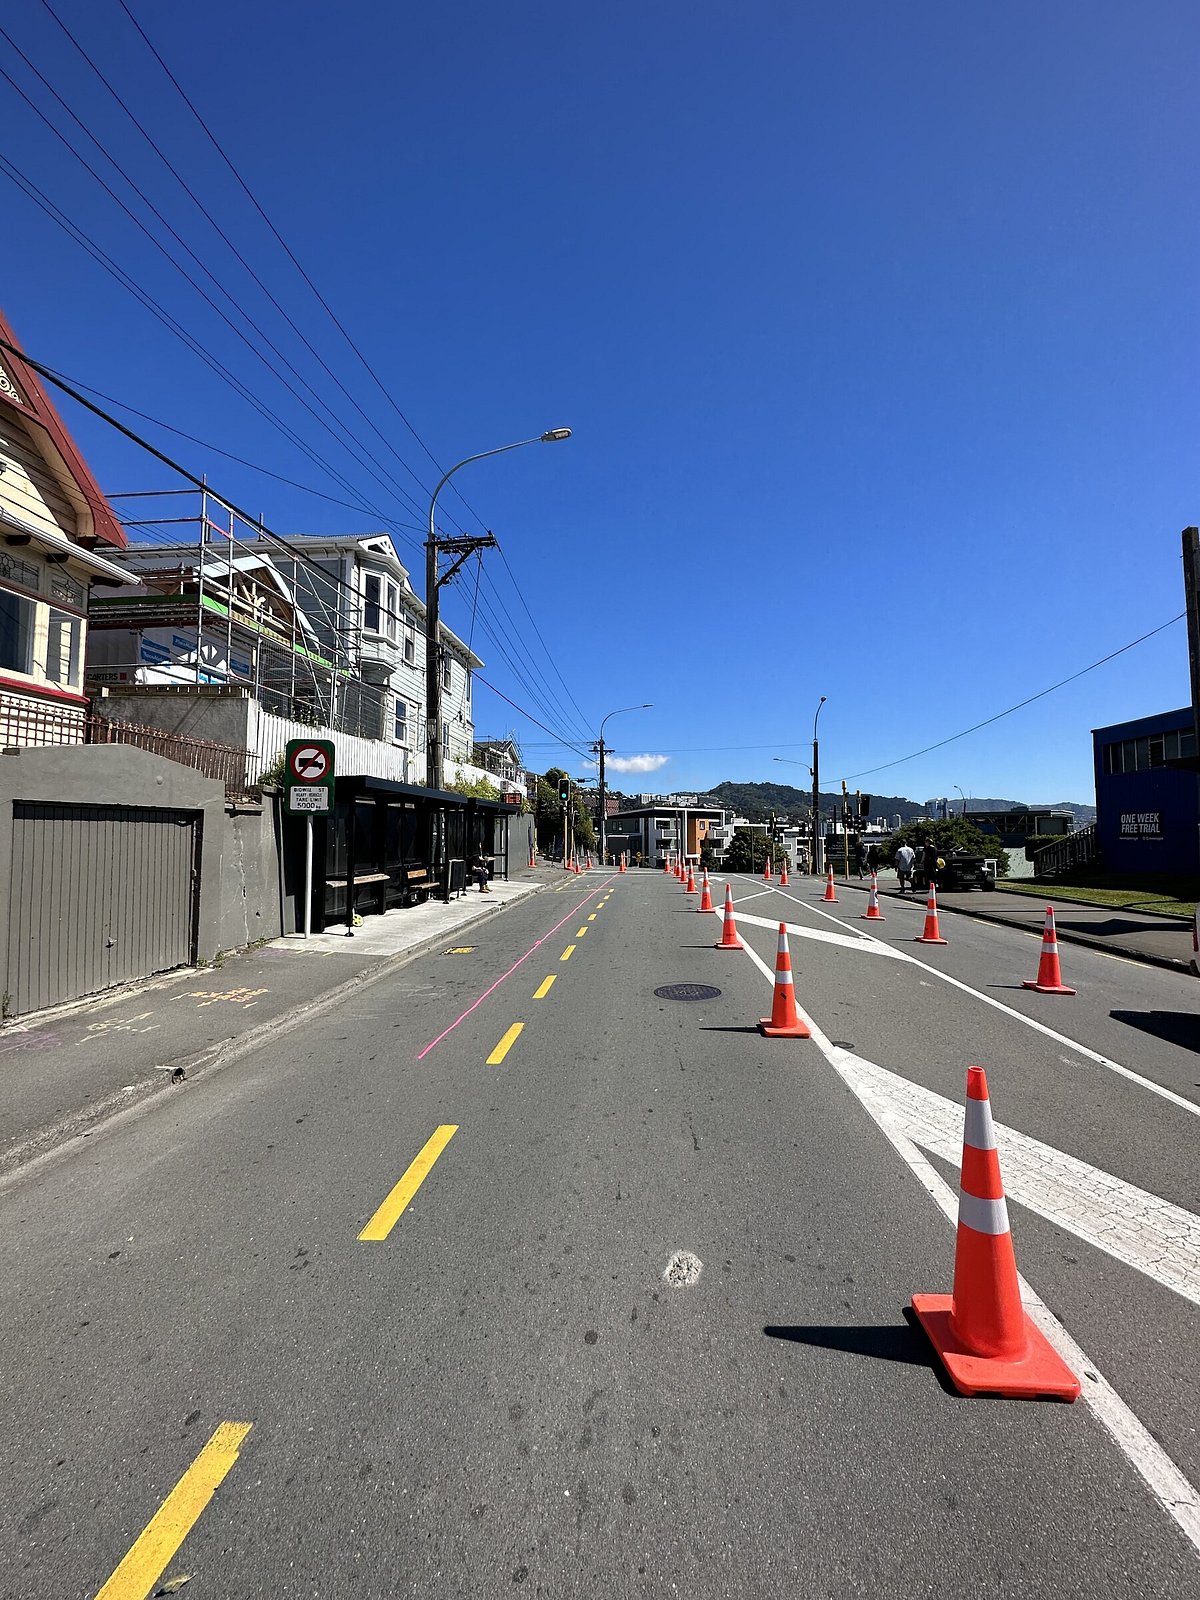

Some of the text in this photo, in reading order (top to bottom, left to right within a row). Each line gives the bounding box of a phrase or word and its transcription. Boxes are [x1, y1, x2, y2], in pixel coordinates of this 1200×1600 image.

[1121, 813, 1159, 823] ONE WEEK
[1121, 823, 1160, 833] FREE TRIAL
